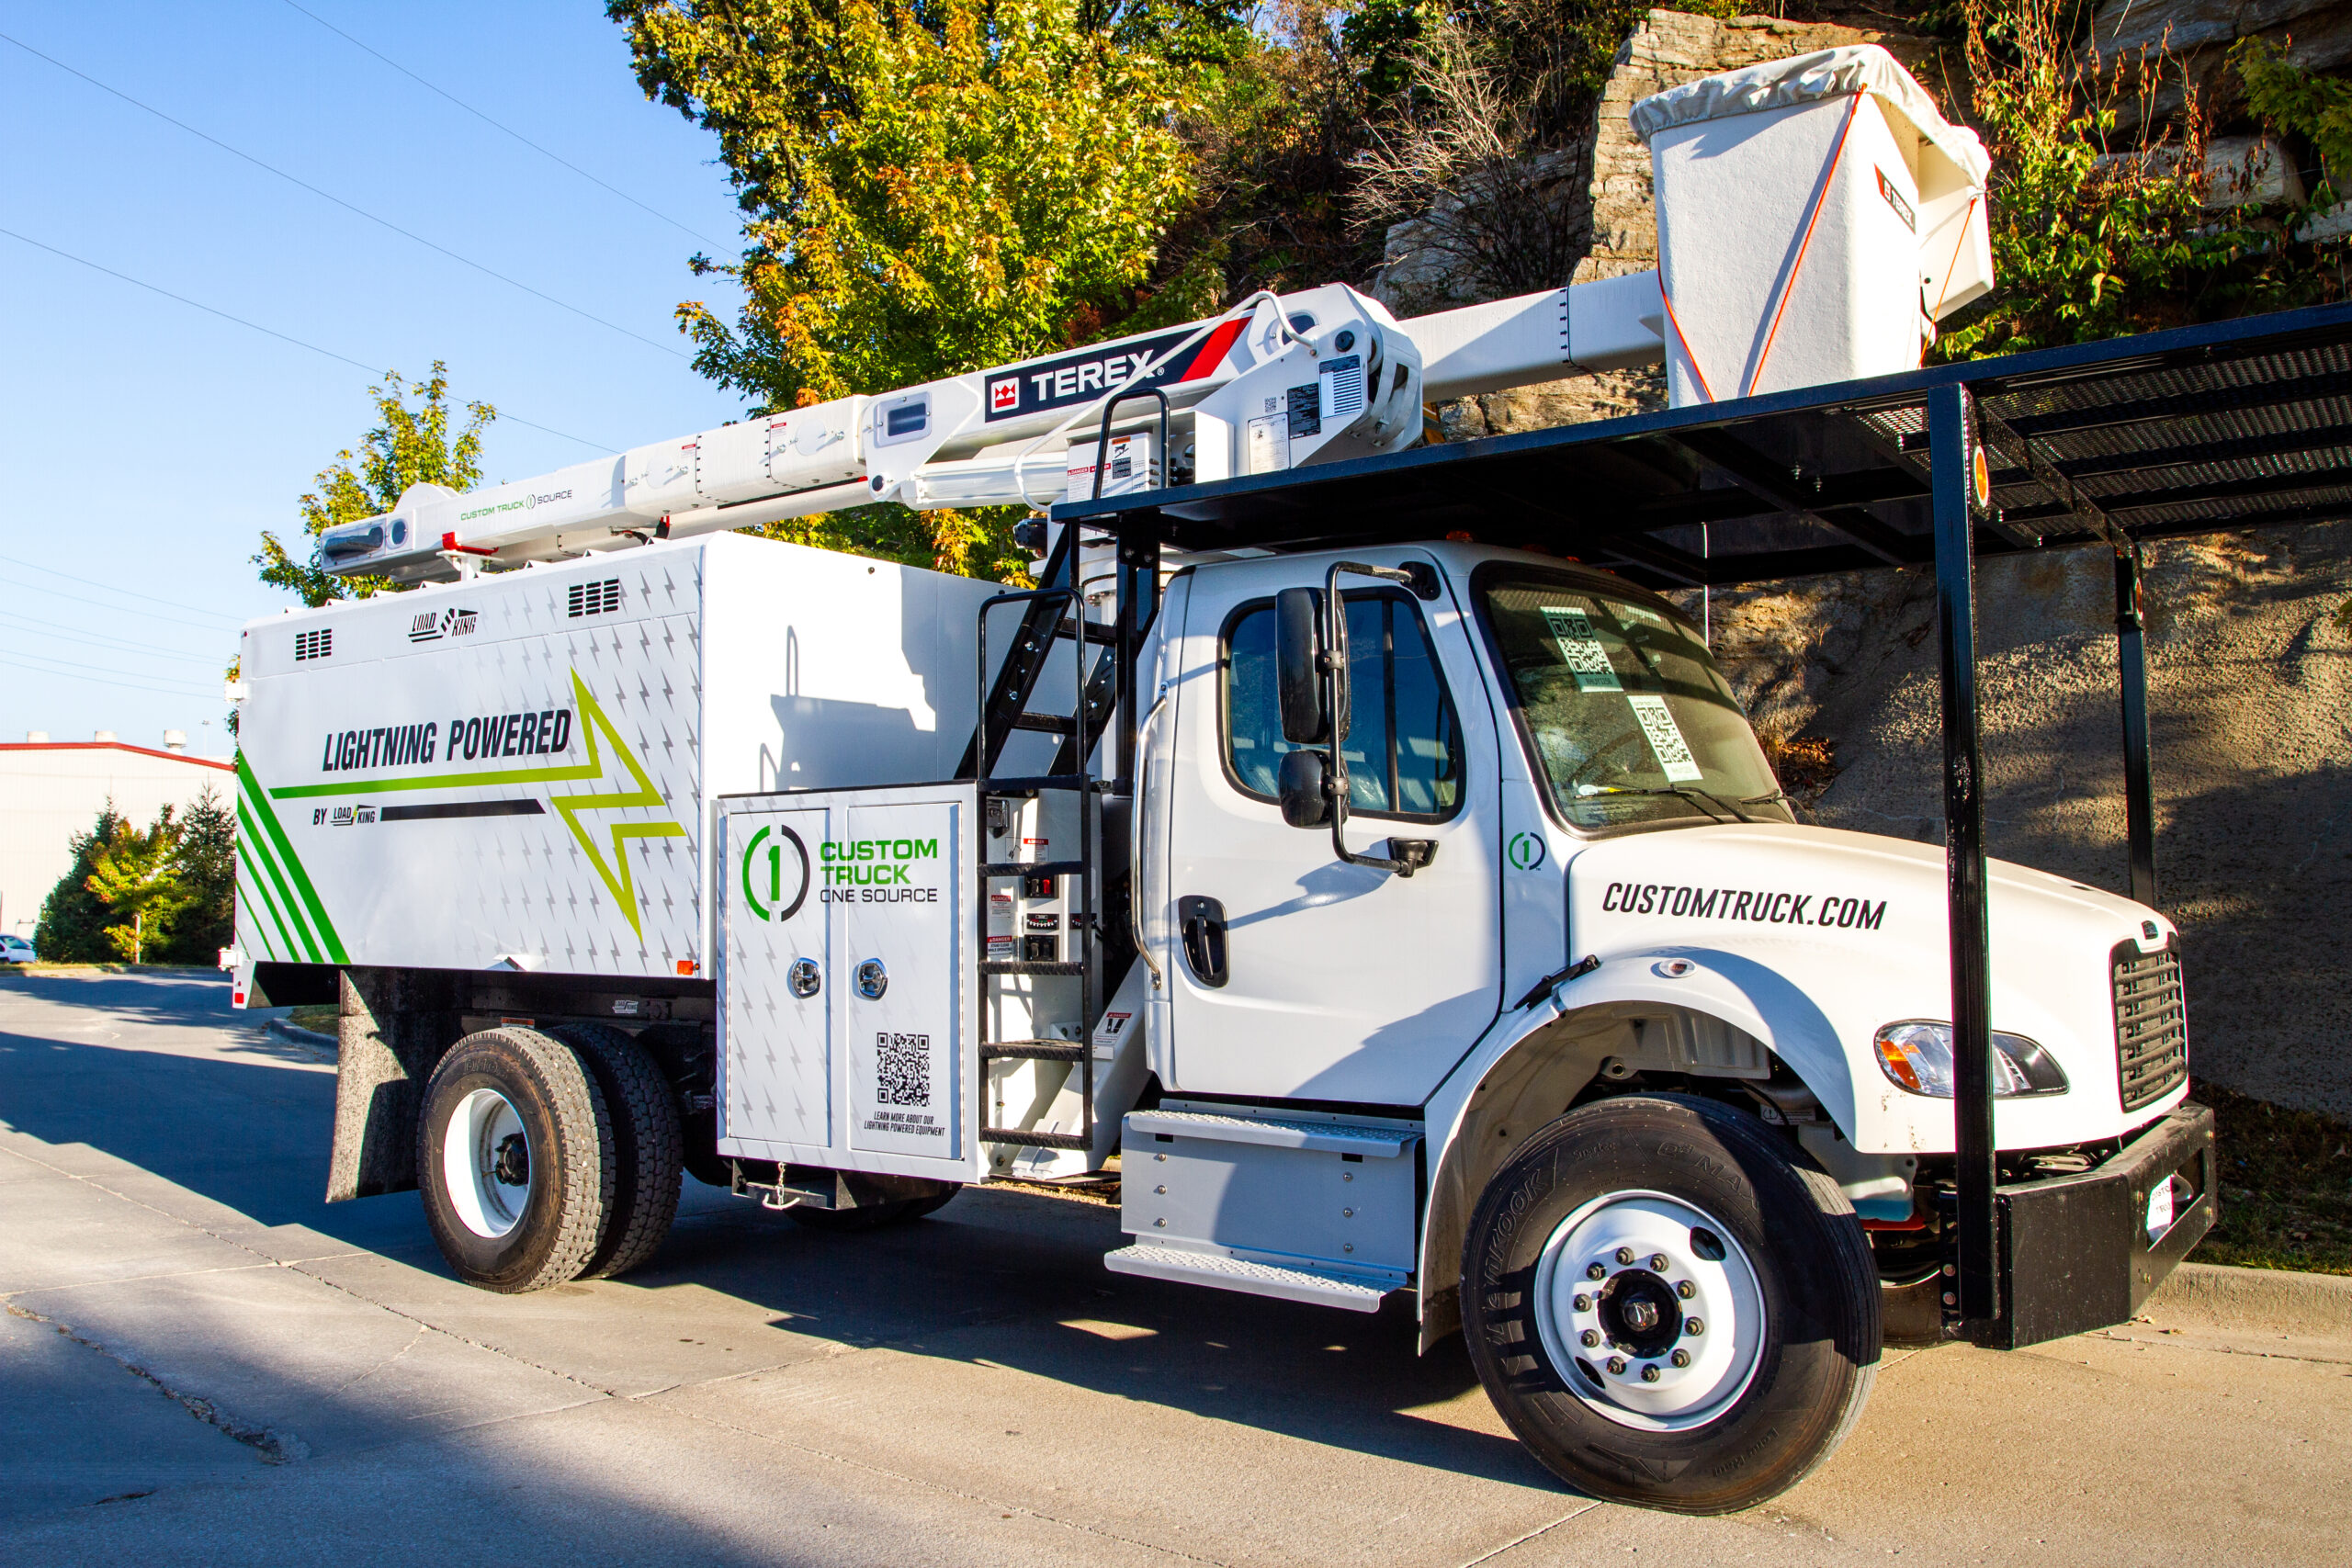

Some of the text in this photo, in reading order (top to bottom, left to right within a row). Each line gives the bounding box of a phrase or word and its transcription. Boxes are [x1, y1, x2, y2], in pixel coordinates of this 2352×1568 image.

[460, 506, 495, 521] CUSTOM
[496, 500, 525, 513] TRUCK
[537, 490, 572, 504] SOURCE
[412, 612, 477, 637] LOAD KING
[322, 709, 571, 772] LIGHTNING POWERED
[312, 807, 376, 826] BY LOAD KING
[820, 839, 938, 862] CUSTOM
[820, 864, 911, 886] TRUCK
[820, 888, 938, 903] ONE SOURCE
[1602, 882, 1887, 931] CUSTOMTRUCK.COM
[864, 1120, 945, 1137] LIGHTNING POWERED EQUIPMENT
[874, 1111, 933, 1125] LEARN MORE ABOUT OUR
